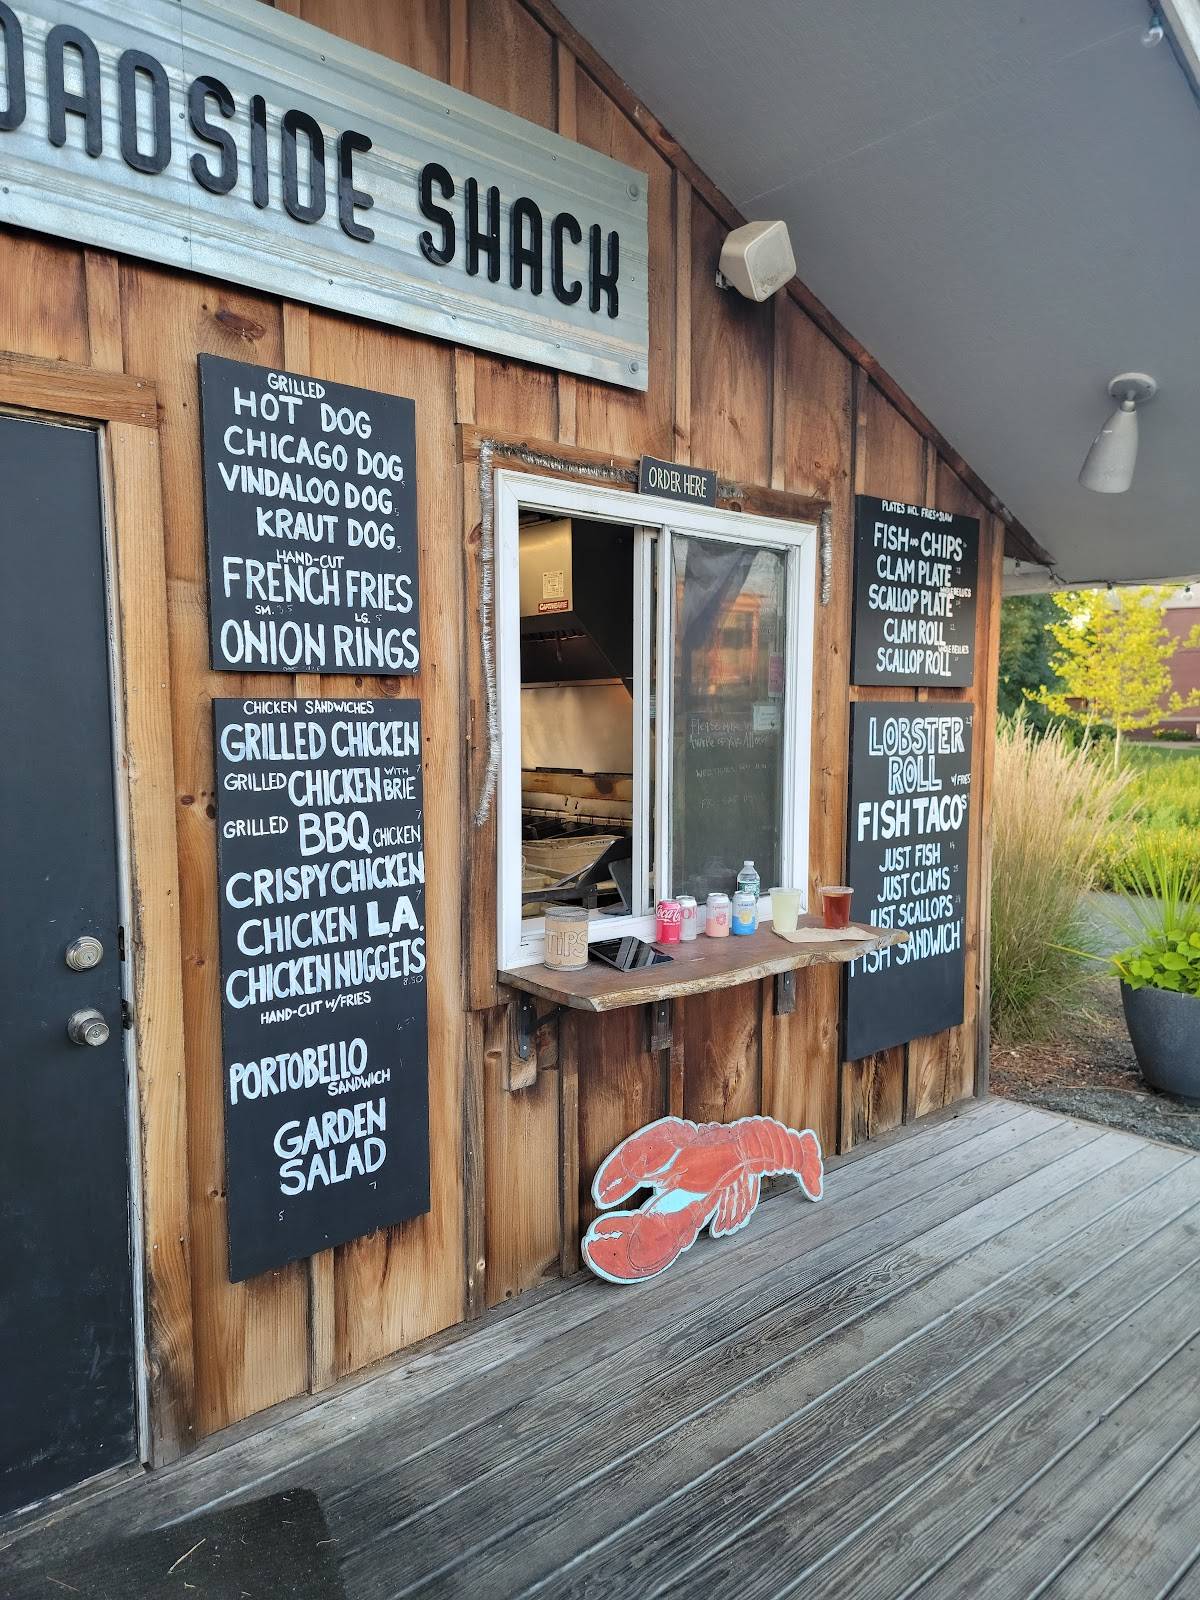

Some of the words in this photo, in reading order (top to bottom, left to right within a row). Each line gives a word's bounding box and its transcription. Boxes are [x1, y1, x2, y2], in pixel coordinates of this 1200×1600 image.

[418, 162, 621, 320] SHACK
[267, 372, 326, 399] GRILLED
[233, 386, 302, 424] HOT
[320, 402, 372, 439] DOG
[223, 425, 348, 472] CHICAGO
[357, 447, 404, 481] DOG
[217, 462, 340, 507] VINDALOO
[344, 481, 393, 514] DOG
[648, 466, 682, 494] ORDER
[683, 474, 708, 498] HERE
[881, 500, 905, 514] PLATES
[256, 506, 339, 543] KRAUT
[347, 518, 396, 550] DOG
[873, 521, 910, 552] FISH
[920, 531, 963, 562] CHIPS
[276, 549, 345, 569] HAND-CUT
[876, 554, 916, 583] CLAM
[917, 559, 953, 588] PLATE
[222, 556, 341, 607] FRENCH
[346, 569, 413, 613] FRIES
[868, 583, 919, 614] SCALLOP
[920, 589, 955, 618] PLATE
[254, 605, 275, 616] SM.
[354, 612, 371, 624] LG.
[220, 619, 326, 667] ONION
[333, 624, 420, 670] RINGS
[883, 618, 917, 644] CLAM
[918, 620, 946, 646] ROLL
[876, 647, 924, 674] SCALLOP
[925, 650, 952, 677] ROLL
[243, 700, 298, 715] CHICKEN
[304, 700, 375, 715] SANDWICHES
[220, 722, 327, 763] GRILLED
[331, 720, 420, 758] CHICKEN
[868, 717, 965, 756] LOBSTER
[223, 772, 288, 792] GRILLED
[287, 766, 383, 807] CHICKEN
[384, 767, 409, 776] WITH
[382, 776, 417, 801] BRIE
[888, 755, 942, 796] ROLL
[223, 815, 289, 839] GRILLED
[298, 811, 373, 857] BBQ
[372, 824, 421, 848] CHICKEN
[857, 799, 911, 842] FISH
[912, 793, 968, 835] TACOS
[879, 846, 912, 872] JUST
[915, 842, 941, 867] FISH
[225, 862, 331, 909] CRISPY
[330, 851, 425, 895] CHICKEN
[877, 872, 911, 903] JUST
[910, 866, 951, 896] CLAMS
[236, 904, 358, 957] CHICKEN
[366, 895, 425, 938] L.A.
[897, 894, 954, 928] SCALLOPS
[545, 929, 588, 959] TIPS
[895, 920, 960, 966] SANDWICH
[225, 953, 332, 1009] CHICKEN
[333, 937, 426, 990] NUGGETS
[260, 1000, 323, 1025] HAND-CUT
[229, 1037, 368, 1106] PORTOBELLO
[327, 1068, 391, 1097] SANDWICH
[273, 1097, 387, 1160] GARDEN
[279, 1137, 387, 1196] SALAD
